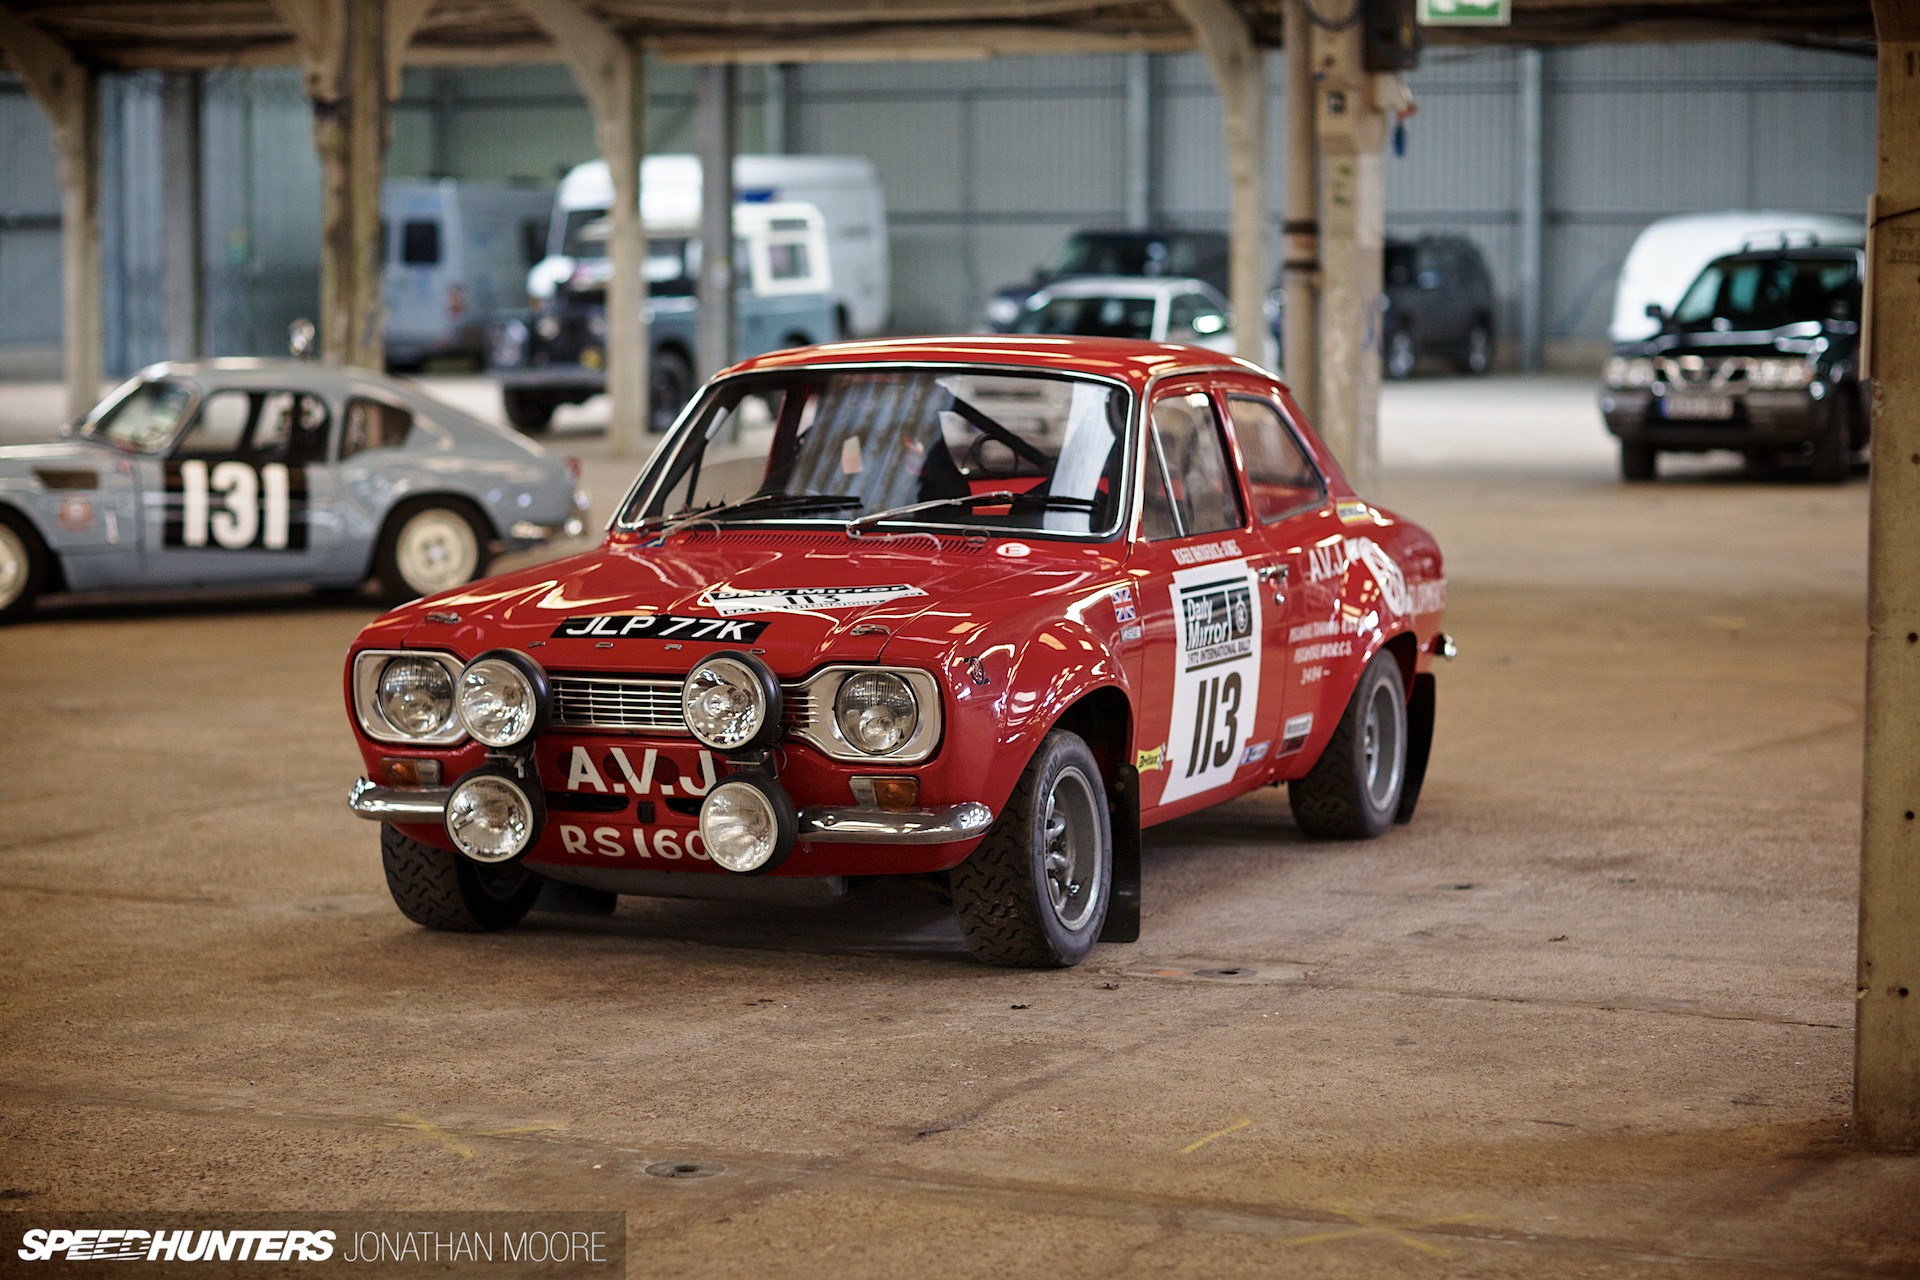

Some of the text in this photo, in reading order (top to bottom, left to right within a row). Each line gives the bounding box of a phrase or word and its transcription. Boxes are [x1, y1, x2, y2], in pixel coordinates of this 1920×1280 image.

[181, 460, 290, 549] 131
[786, 593, 841, 605] 113
[797, 584, 906, 595] Mirror
[1187, 595, 1212, 624] Daily
[567, 616, 756, 641] JLP 77K
[1187, 620, 1229, 650] Mirror
[1186, 671, 1242, 778] 113
